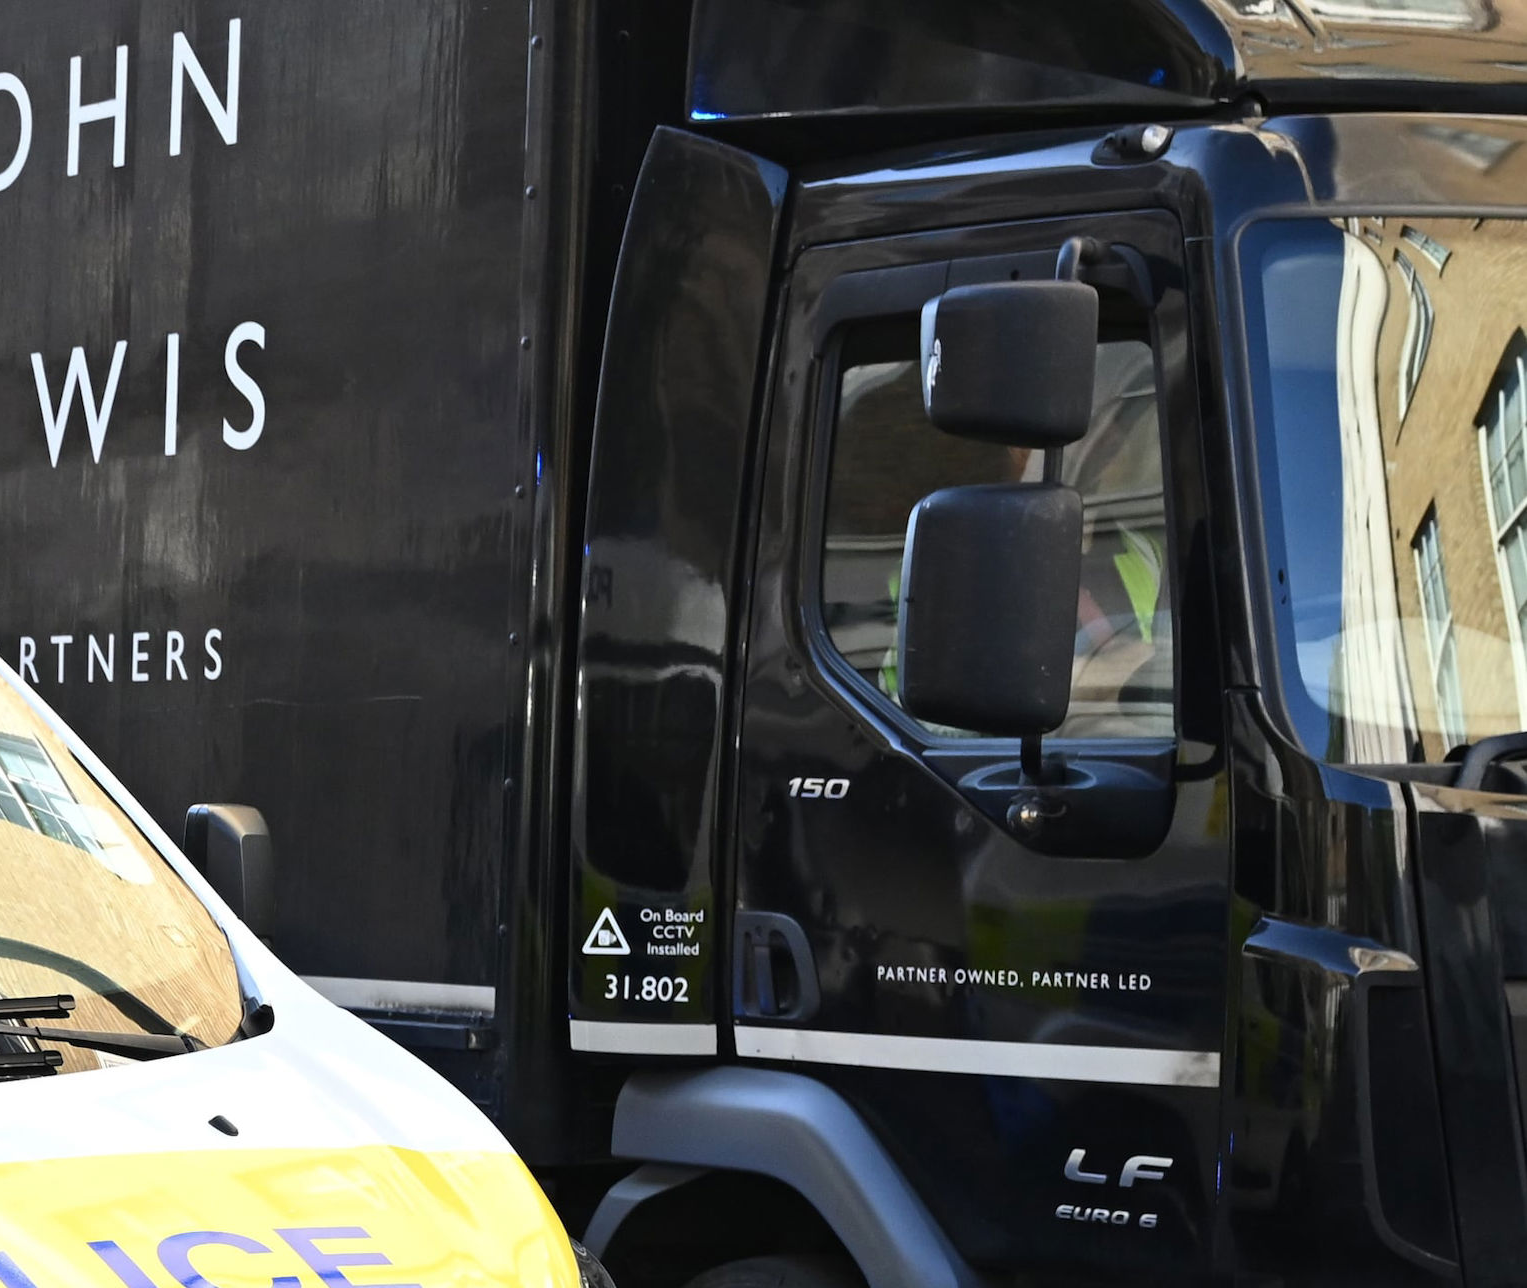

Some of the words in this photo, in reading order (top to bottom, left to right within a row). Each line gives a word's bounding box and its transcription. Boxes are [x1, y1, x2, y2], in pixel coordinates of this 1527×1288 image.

[788, 776, 850, 800] 150
[639, 907, 662, 923] On
[664, 907, 705, 923] Board
[652, 924, 696, 939] CCTV
[646, 941, 701, 956] Installed
[603, 972, 690, 1003] 31.802
[876, 964, 948, 984] PARTNER
[953, 968, 1025, 988] OWNED,
[1030, 970, 1111, 990] PARTNER
[1117, 973, 1152, 991] LED
[1063, 1147, 1175, 1188] LF
[1054, 1203, 1131, 1226] EURO
[1138, 1212, 1159, 1229] 6
